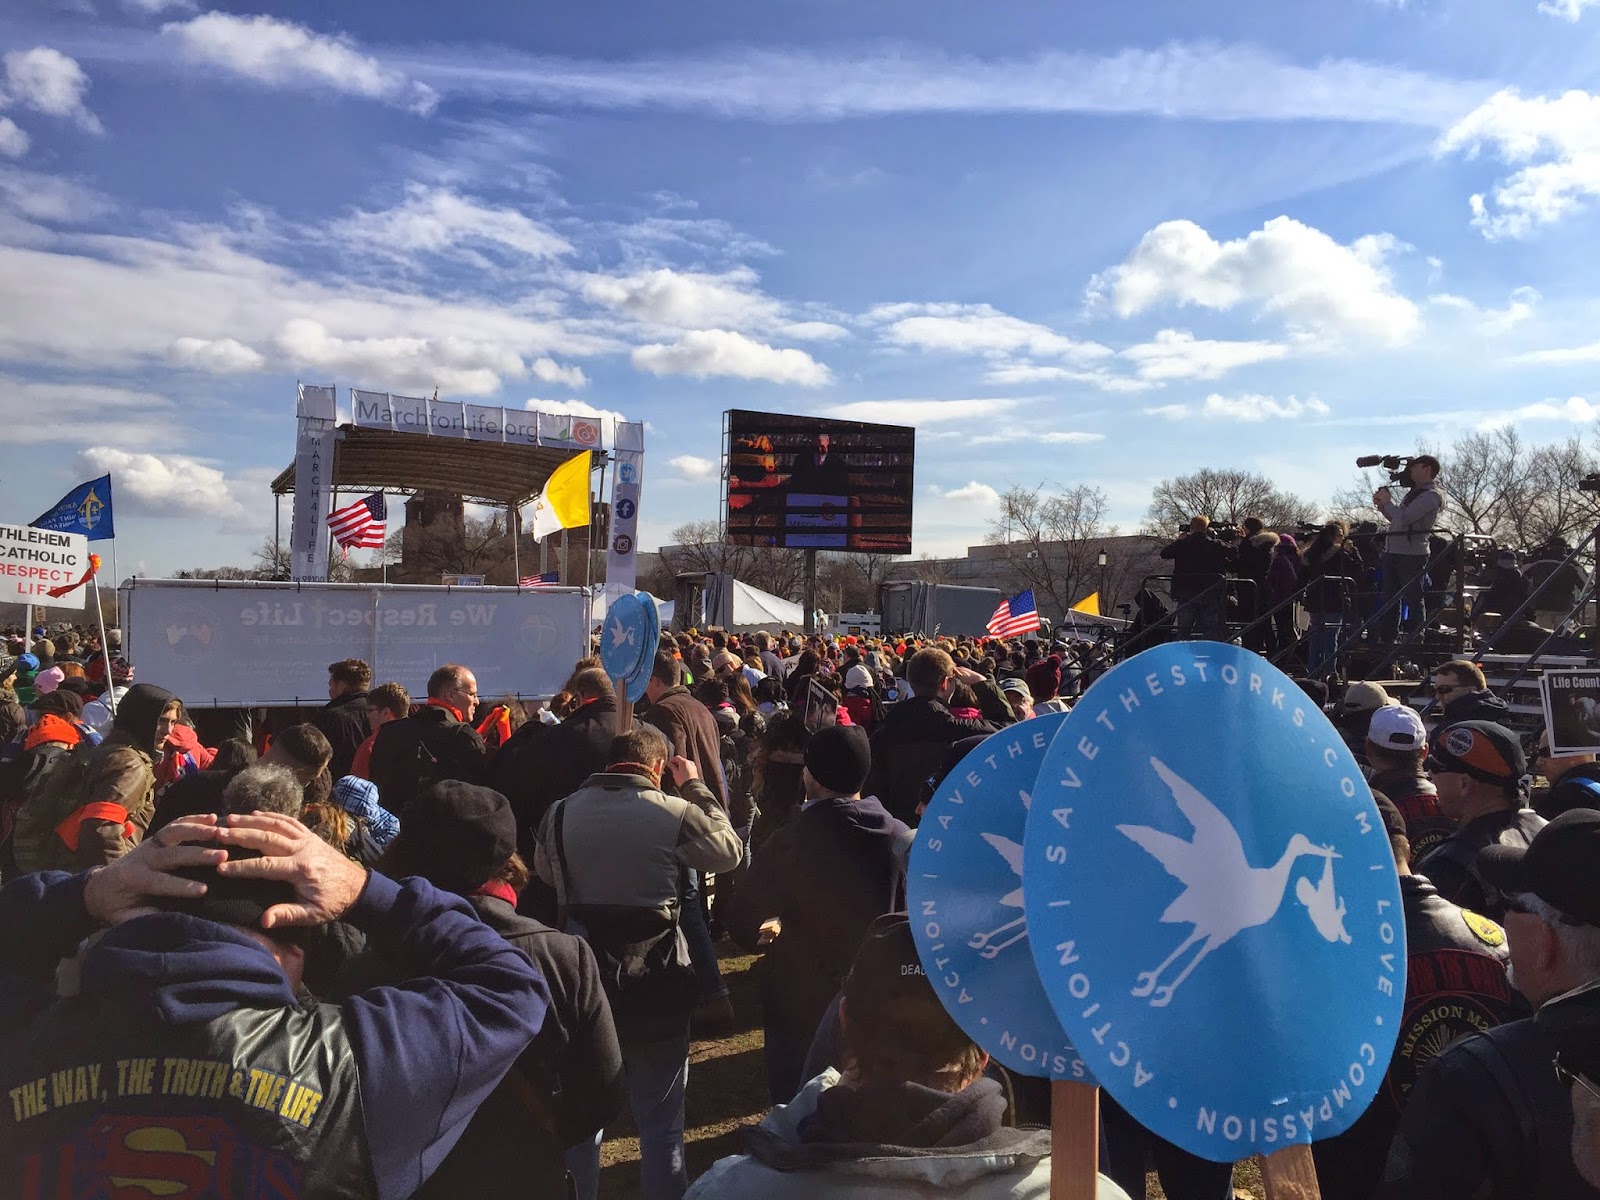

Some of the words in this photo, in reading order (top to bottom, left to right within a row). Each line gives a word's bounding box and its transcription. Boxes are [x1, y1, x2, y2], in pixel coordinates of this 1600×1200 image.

[357, 400, 538, 443] MarchforLife.org
[1411, 834, 1444, 860] ISSION
[921, 899, 973, 1005] ACTION
[1376, 900, 1395, 998] LOVE
[1056, 940, 1154, 1089] ACTION
[1400, 1005, 1464, 1059] MISSION
[1000, 1030, 1085, 1077] SSION
[8, 1077, 47, 1122] THE
[50, 1063, 108, 1108] WAY,
[117, 1058, 157, 1097] THE
[161, 1057, 231, 1099] TRUTH
[229, 1071, 245, 1097] &
[244, 1068, 286, 1110] THE
[279, 1083, 324, 1128] LIFE
[1199, 1044, 1378, 1145] COMPASSION
